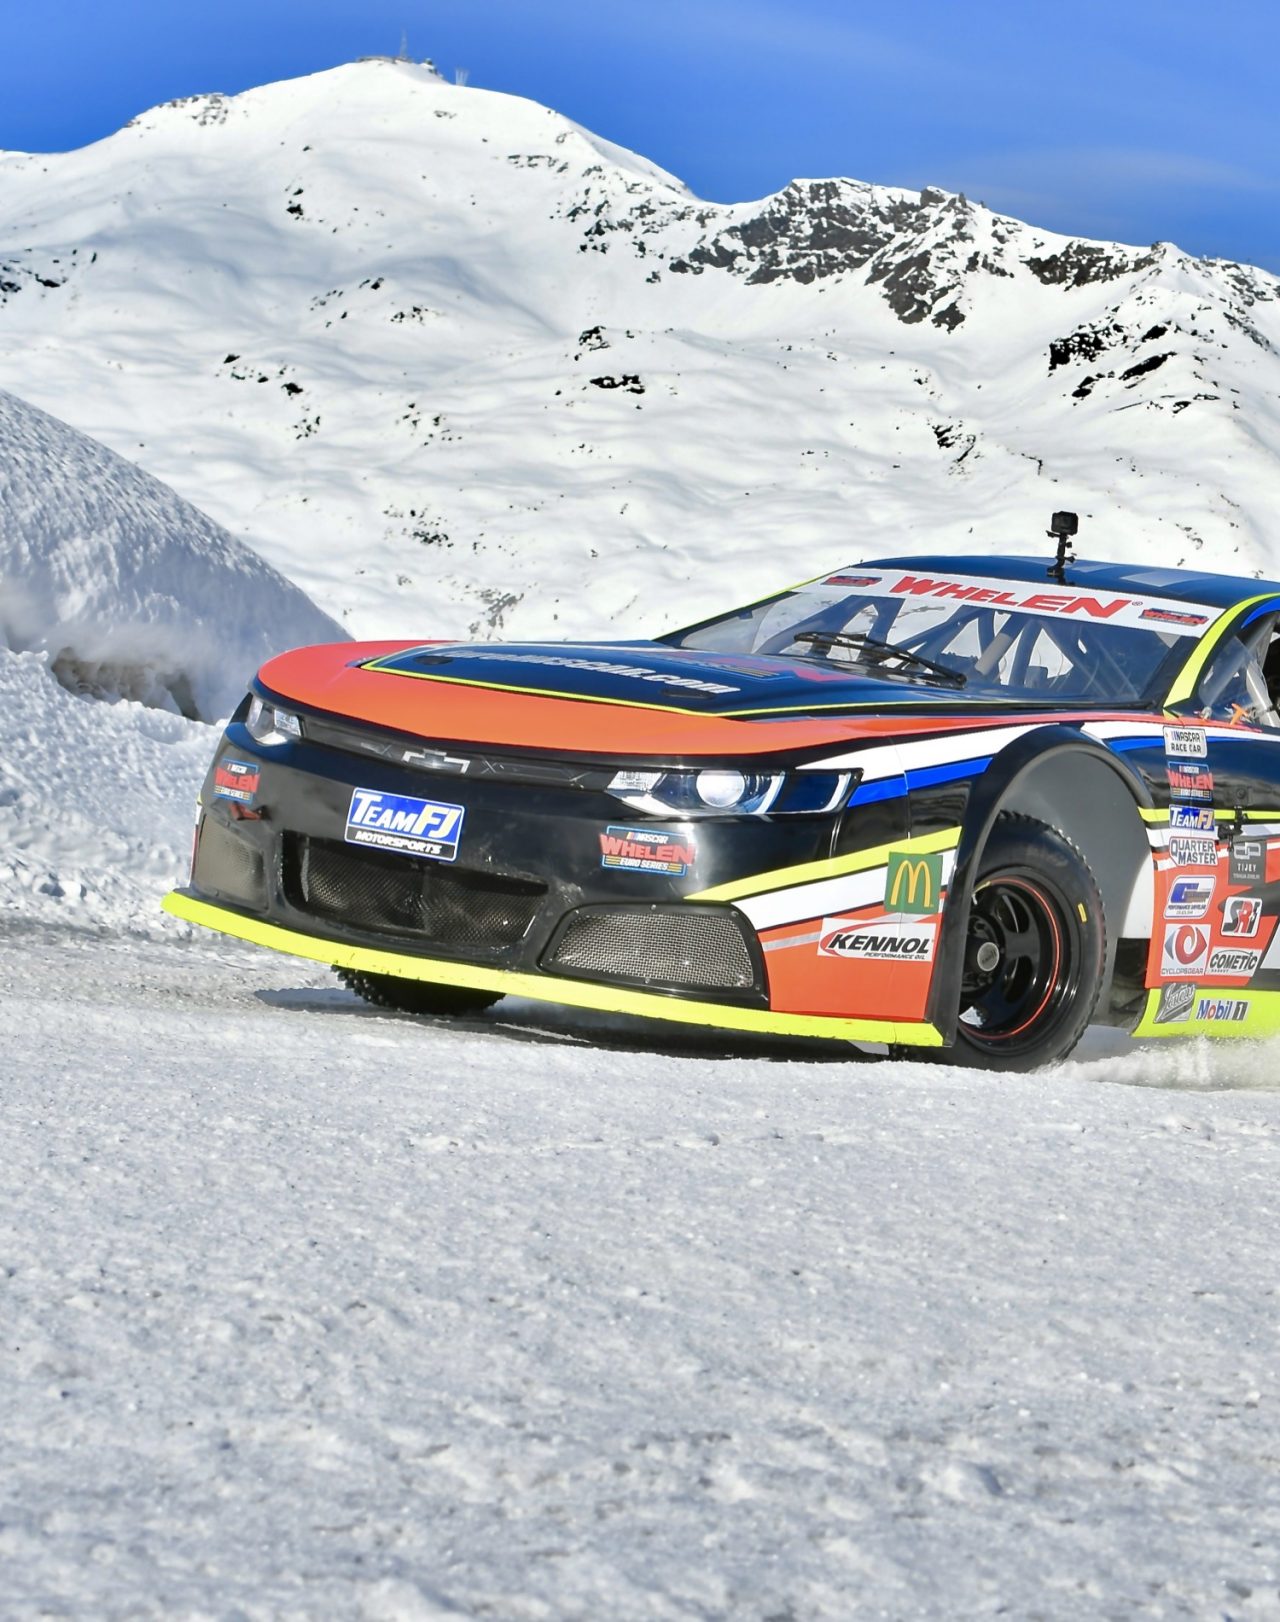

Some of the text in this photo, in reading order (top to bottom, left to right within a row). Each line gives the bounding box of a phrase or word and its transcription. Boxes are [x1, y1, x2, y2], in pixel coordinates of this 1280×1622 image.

[888, 575, 1133, 618] WHELEN
[1171, 743, 1202, 753] RACE CAR
[1166, 768, 1213, 790] WHELEN
[355, 830, 442, 855] MOTORSPORTS
[599, 833, 697, 865] WHELEN
[1171, 840, 1214, 857] QUARTER
[620, 858, 669, 871] EURO SERIES
[1178, 852, 1216, 865] MASTER
[828, 934, 930, 954] KENNOL
[1210, 952, 1258, 970] COMETIC
[1161, 967, 1204, 976] CYCLOPSGEAR
[1196, 1000, 1248, 1020] Mobil 1
